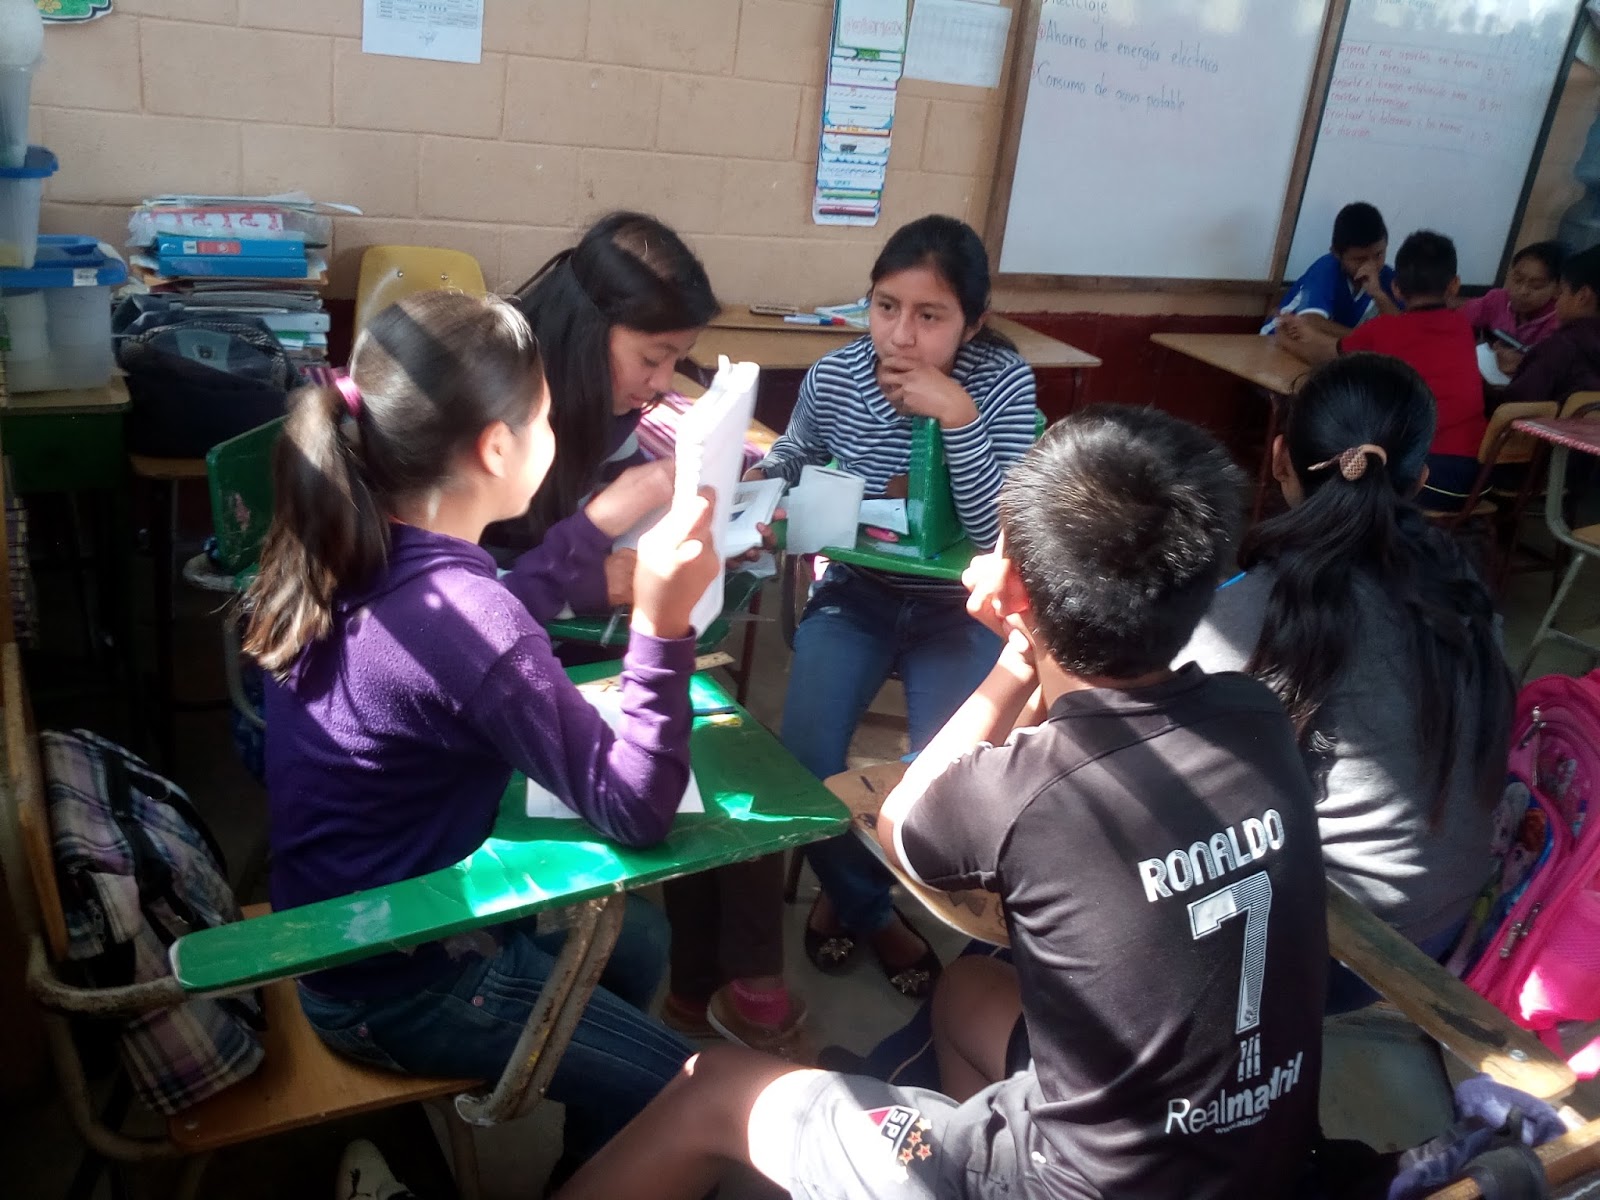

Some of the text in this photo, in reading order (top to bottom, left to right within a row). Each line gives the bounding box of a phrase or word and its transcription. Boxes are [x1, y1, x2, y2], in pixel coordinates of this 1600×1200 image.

[1045, 19, 1087, 49] Ahorro
[1094, 25, 1109, 51] de
[1116, 40, 1160, 71] energía
[1094, 72, 1107, 97] de
[1138, 809, 1285, 902] RONALDO
[1187, 870, 1272, 1035] 7
